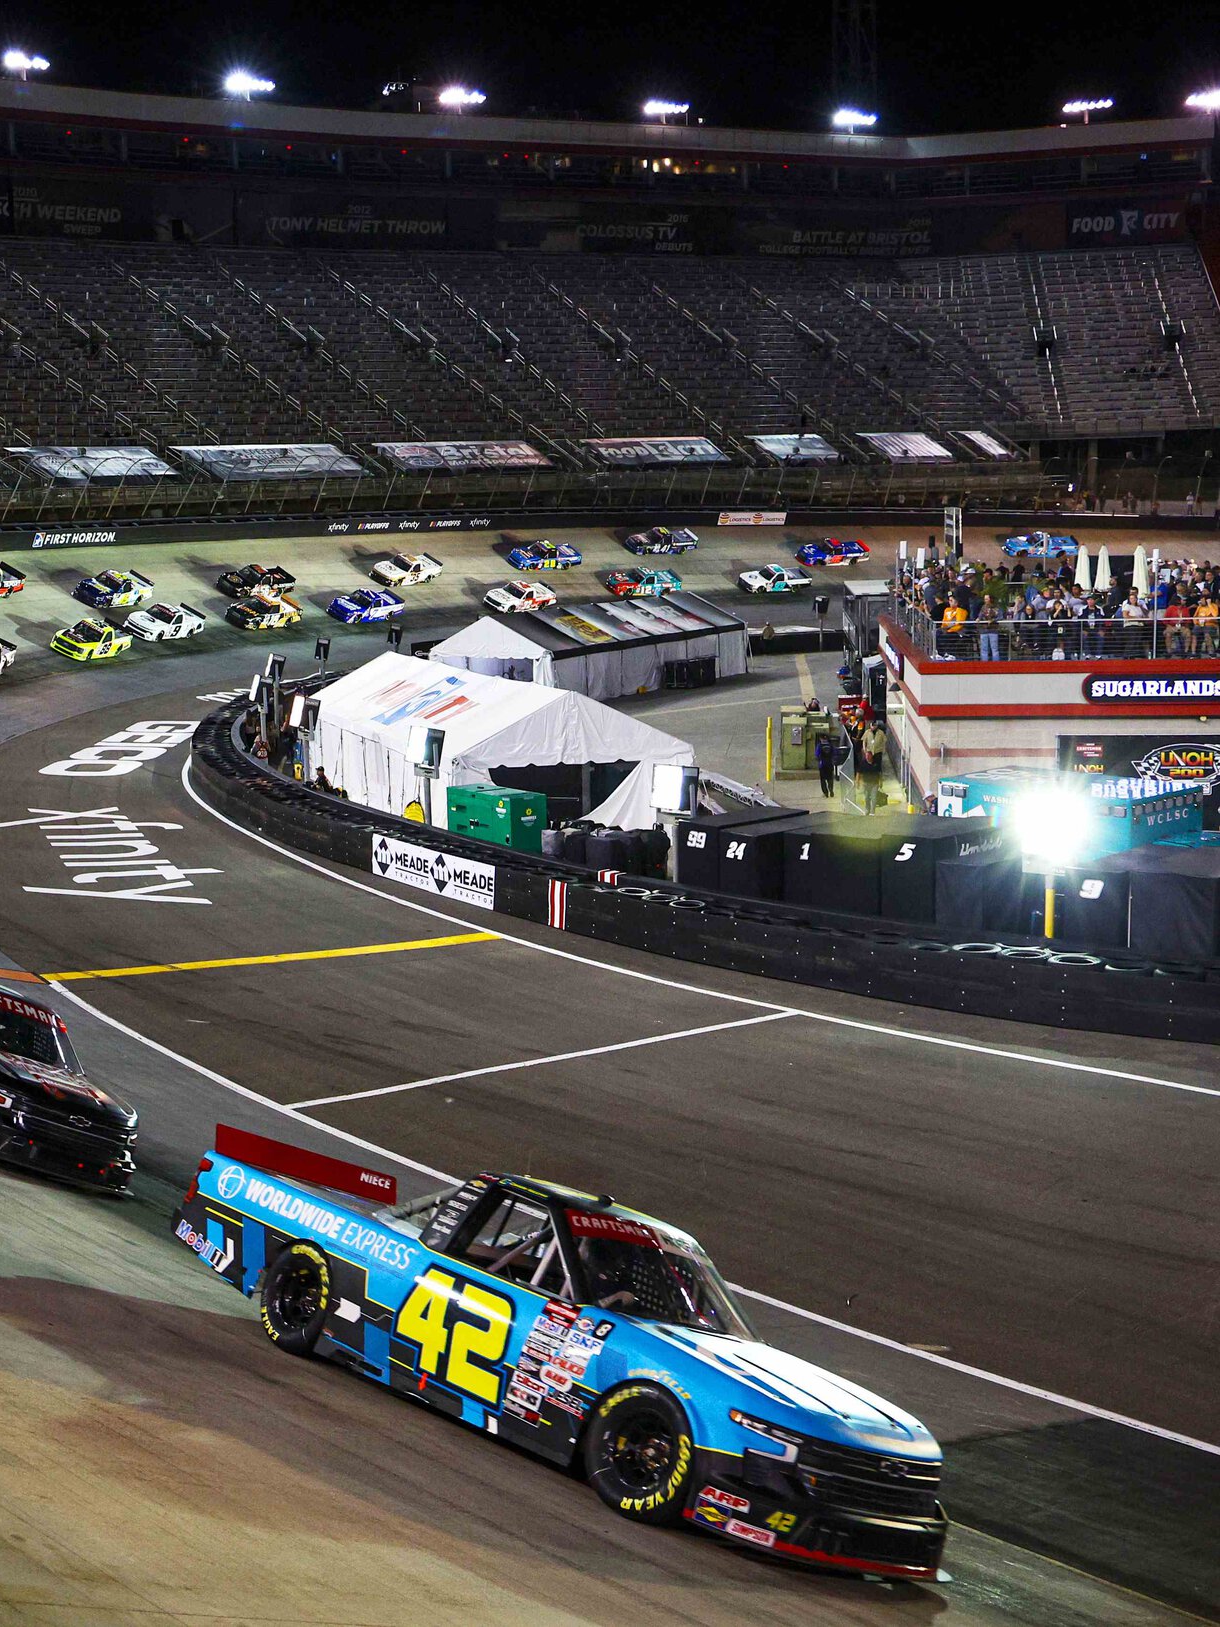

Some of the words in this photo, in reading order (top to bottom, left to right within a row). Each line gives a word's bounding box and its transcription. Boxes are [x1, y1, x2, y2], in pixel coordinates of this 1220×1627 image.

[37, 204, 122, 223] WEEKEND
[1072, 215, 1115, 233] FOOD
[1142, 212, 1180, 230] CITY
[63, 223, 102, 235] SWEEP
[269, 216, 314, 231] TONY
[316, 217, 383, 234] HELMET
[386, 219, 447, 235] THROW
[576, 222, 653, 240] COLOSSUS
[656, 226, 677, 241] TV
[792, 230, 845, 244] BATTLE
[847, 231, 866, 244] AT
[867, 231, 932, 245] BRISTOL
[44, 533, 72, 545] FIRST
[38, 720, 201, 777] GEICO
[1160, 751, 1214, 767] UNOH
[1169, 769, 1204, 778] 200
[1146, 808, 1190, 827] WCLSC
[686, 830, 706, 849] 99
[725, 841, 746, 861] 24
[799, 842, 811, 860] 1
[894, 843, 915, 862] 5
[395, 850, 429, 875] MEADE
[395, 871, 430, 887] TRACTOR
[453, 868, 494, 893] MEADE
[454, 888, 494, 905] TRACTOR
[360, 1171, 391, 1190] NIECE
[244, 1178, 342, 1239] WORLDWIDE
[341, 1220, 416, 1270] EXPRESS
[572, 1215, 653, 1240] CRAFTSMAN
[174, 1219, 214, 1262] Mobil
[260, 1306, 280, 1341] EAGLE
[595, 1323, 613, 1338] 8
[396, 1267, 514, 1405] 42
[569, 1332, 601, 1351] SKF
[703, 1486, 749, 1509] ARP
[765, 1510, 797, 1533] 42
[730, 1522, 772, 1544] SIMPSON
